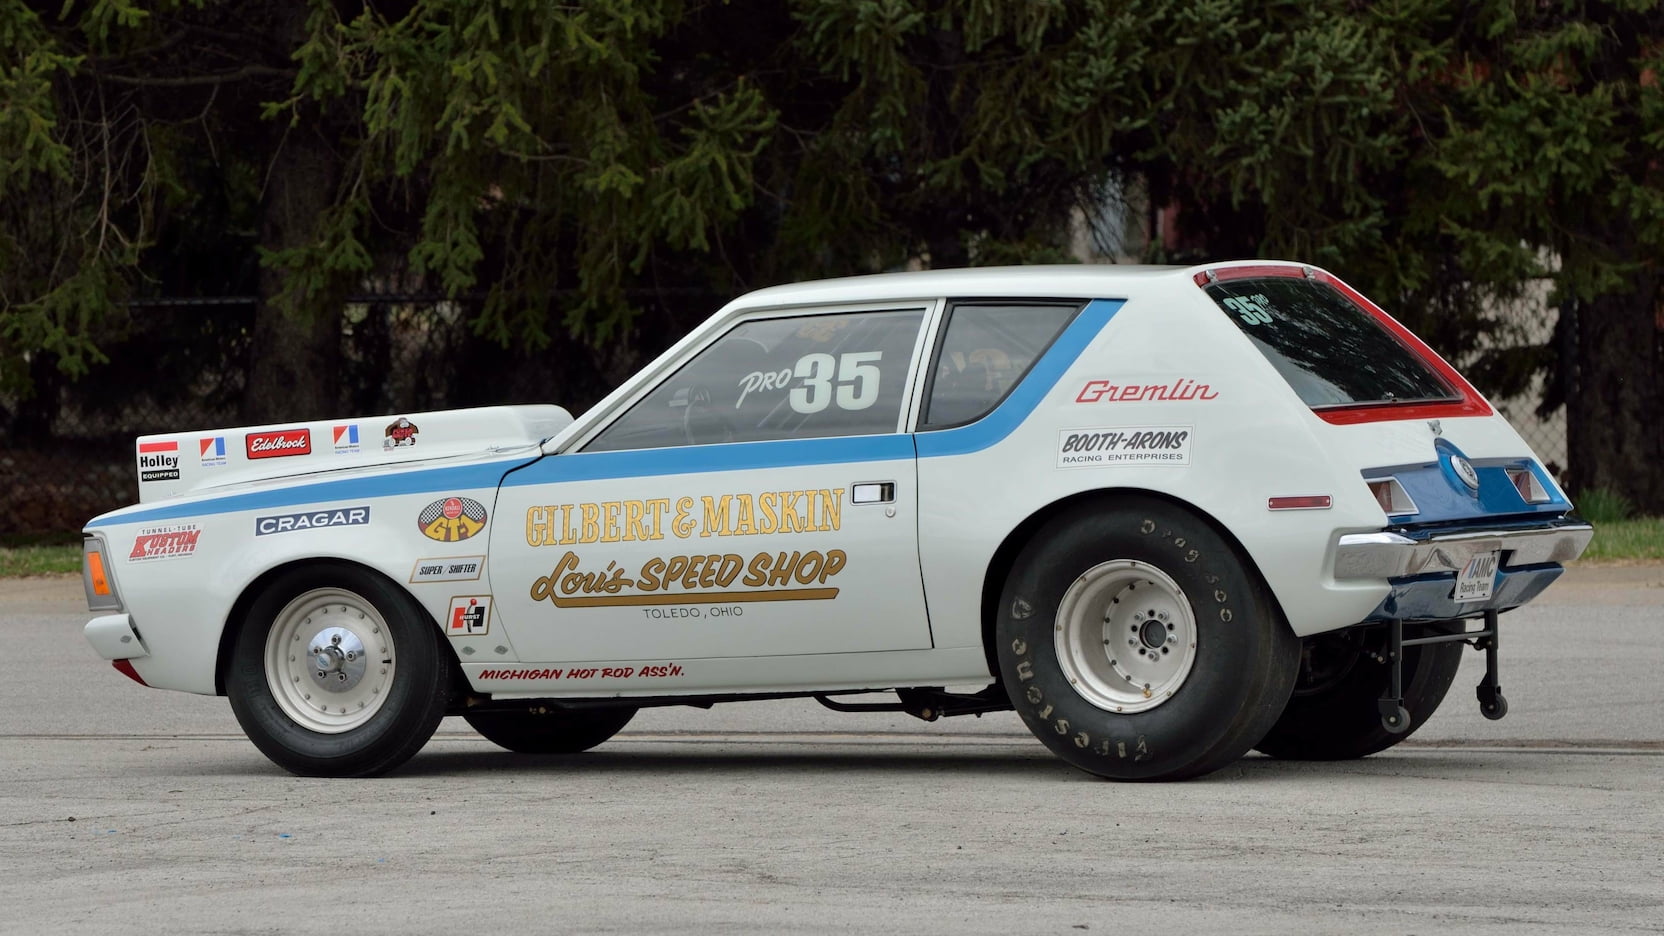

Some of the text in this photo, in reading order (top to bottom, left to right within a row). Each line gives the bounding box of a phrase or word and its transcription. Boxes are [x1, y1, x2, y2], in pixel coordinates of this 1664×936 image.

[1223, 296, 1273, 325] 35
[736, 350, 882, 414] PRO 35
[1075, 378, 1219, 403] Gremlin
[250, 434, 306, 452] Edelbrock
[1062, 431, 1188, 453] BOOTH-ARONS
[140, 455, 178, 468] Holley
[1063, 453, 1183, 463] RACING ENTERPRISES
[142, 471, 178, 480] EQUIPPED
[260, 509, 366, 534] CRAGAR
[525, 487, 845, 547] GILBERT & MASKIN
[129, 529, 201, 558] KUSTOM
[636, 554, 743, 591] SPEED
[743, 550, 847, 587] SHOP
[1472, 556, 1495, 578] AMC
[1460, 581, 1489, 594] Racing Team
[710, 606, 743, 617] OHIO
[479, 669, 563, 680] MICHIGAN
[566, 668, 598, 679] HOT
[601, 667, 634, 678] ROD
